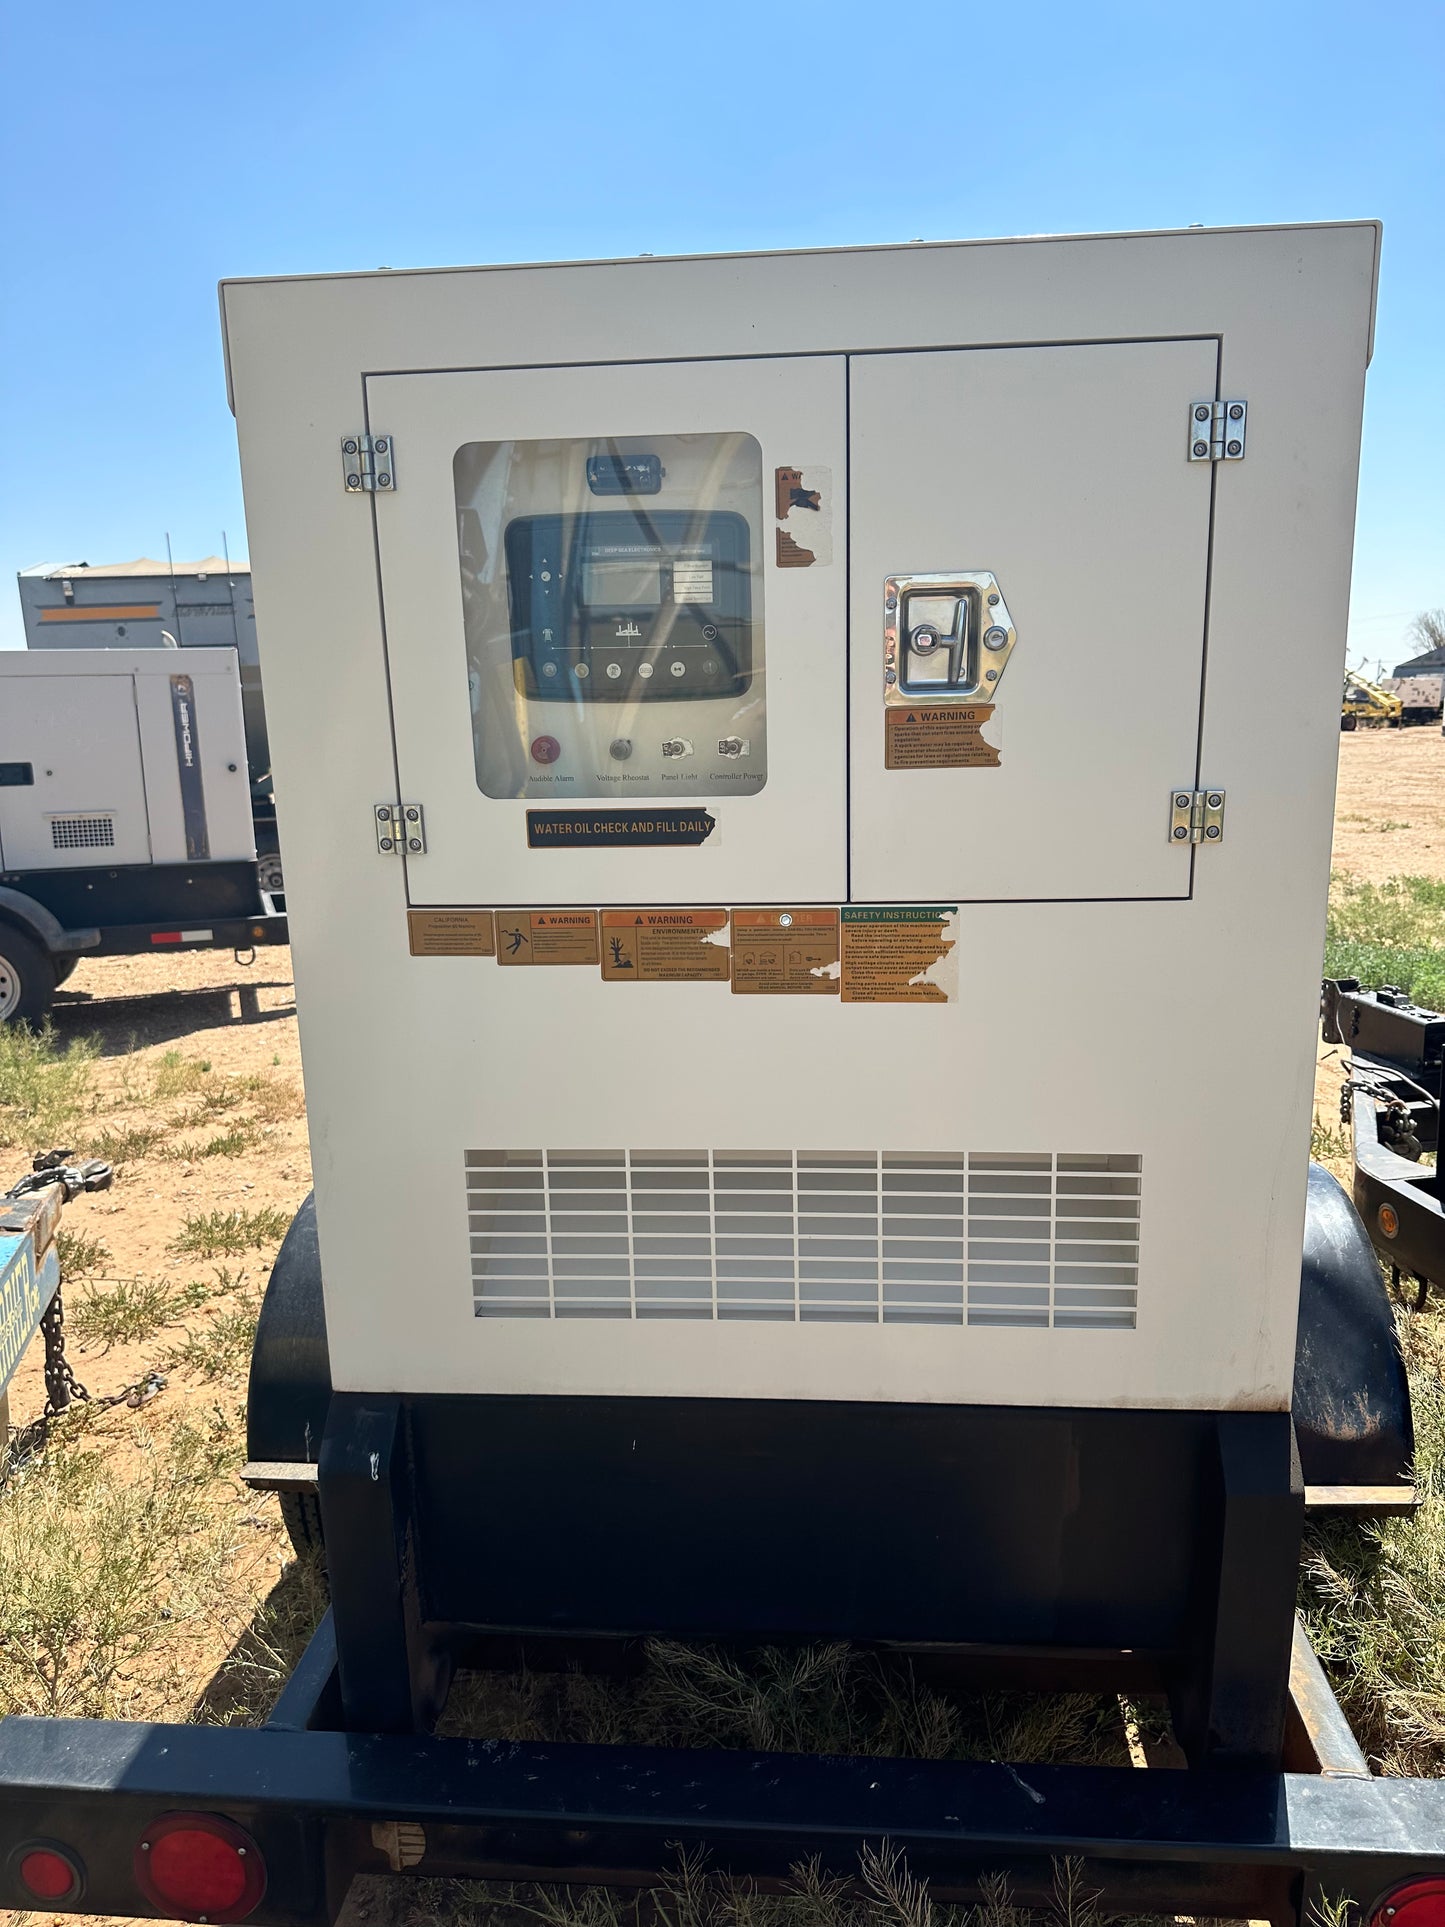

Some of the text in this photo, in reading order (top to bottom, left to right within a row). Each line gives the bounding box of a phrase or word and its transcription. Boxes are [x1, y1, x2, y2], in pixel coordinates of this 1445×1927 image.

[921, 712, 975, 721] WARNING
[180, 702, 193, 767] HIPOWER
[534, 821, 711, 834] WATER OIL CHECK AND FILL DAILY
